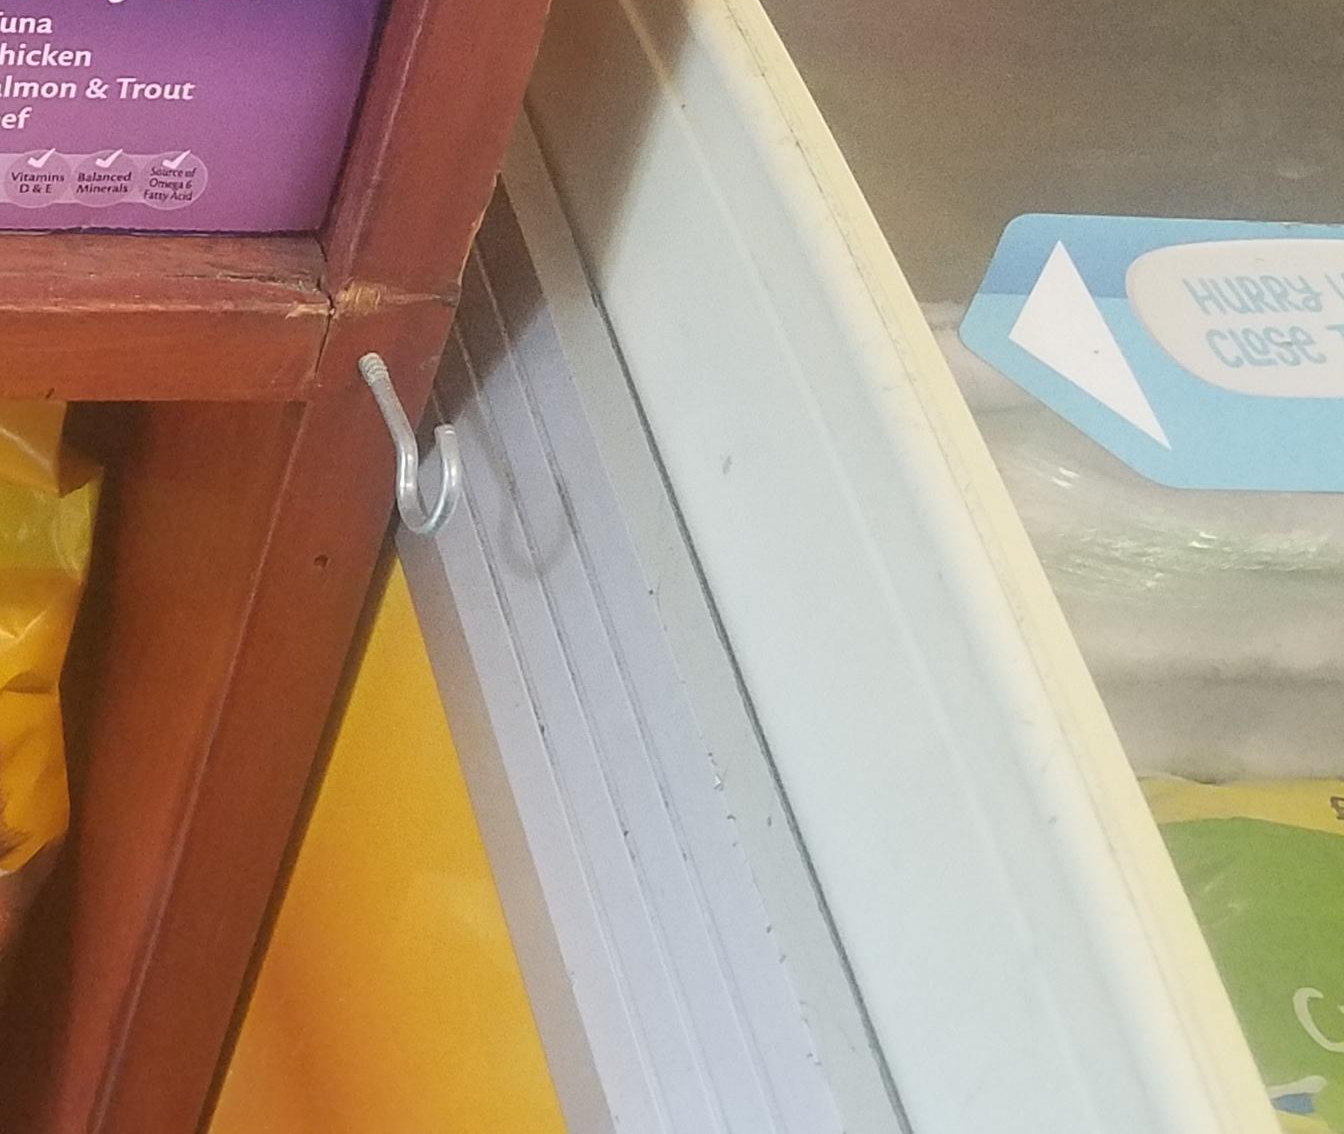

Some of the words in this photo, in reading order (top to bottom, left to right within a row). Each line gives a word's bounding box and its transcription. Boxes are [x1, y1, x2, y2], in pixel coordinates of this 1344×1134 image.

[84, 79, 107, 99] &
[117, 77, 196, 101] Trout
[11, 171, 65, 184] Vitamins
[77, 171, 132, 183] Balanced
[149, 166, 184, 178] Source
[185, 166, 197, 178] of
[18, 183, 30, 194] D
[31, 183, 43, 194] &
[76, 183, 129, 195] Minerals
[148, 178, 183, 191] Omega
[143, 189, 168, 202] Fatty
[169, 190, 193, 202] Acid
